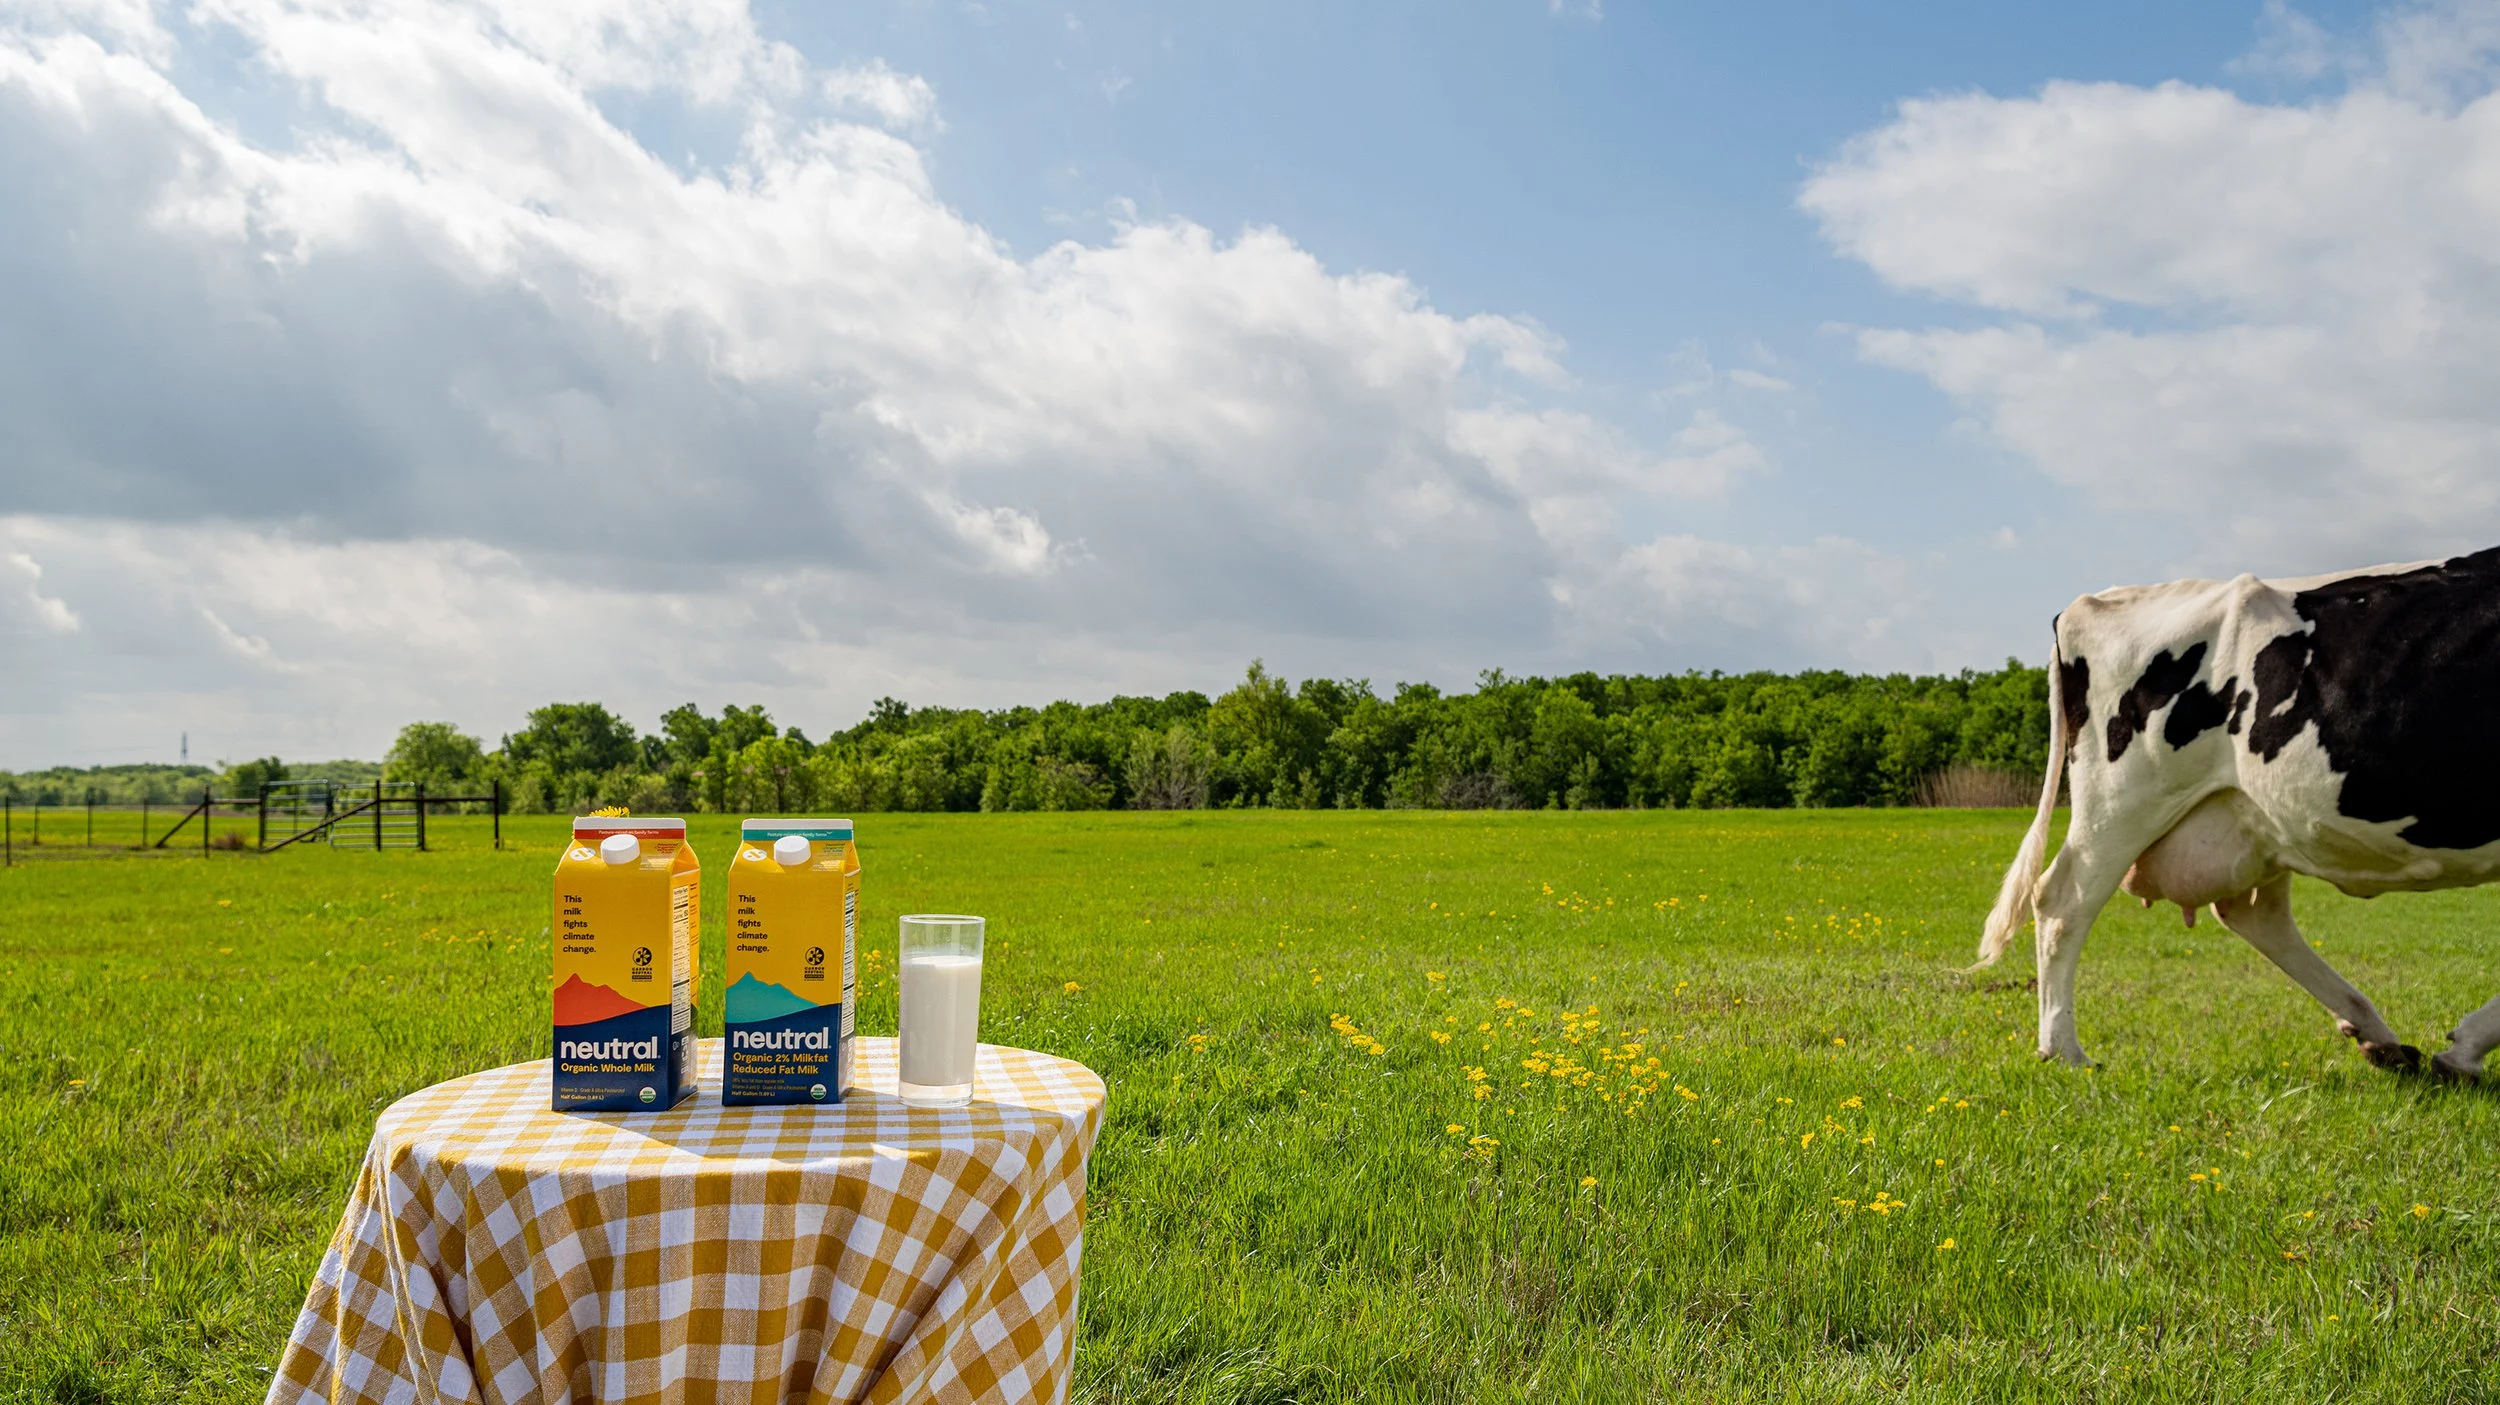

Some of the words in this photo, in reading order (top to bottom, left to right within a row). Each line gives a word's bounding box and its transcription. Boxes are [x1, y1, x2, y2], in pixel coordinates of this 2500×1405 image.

[738, 894, 756, 902] This
[563, 920, 588, 929] fights
[737, 919, 761, 928] fights
[563, 945, 596, 954] change.
[737, 944, 769, 952] change.
[733, 1052, 773, 1064] Organic
[776, 1054, 790, 1062] 2%
[792, 1053, 828, 1062] Milkfat
[561, 1063, 598, 1074] Organic
[600, 1064, 632, 1072] Whole
[634, 1063, 655, 1072] Milk
[733, 1064, 776, 1074] Reduced
[779, 1065, 795, 1074] Fat
[797, 1065, 818, 1074] Milk
